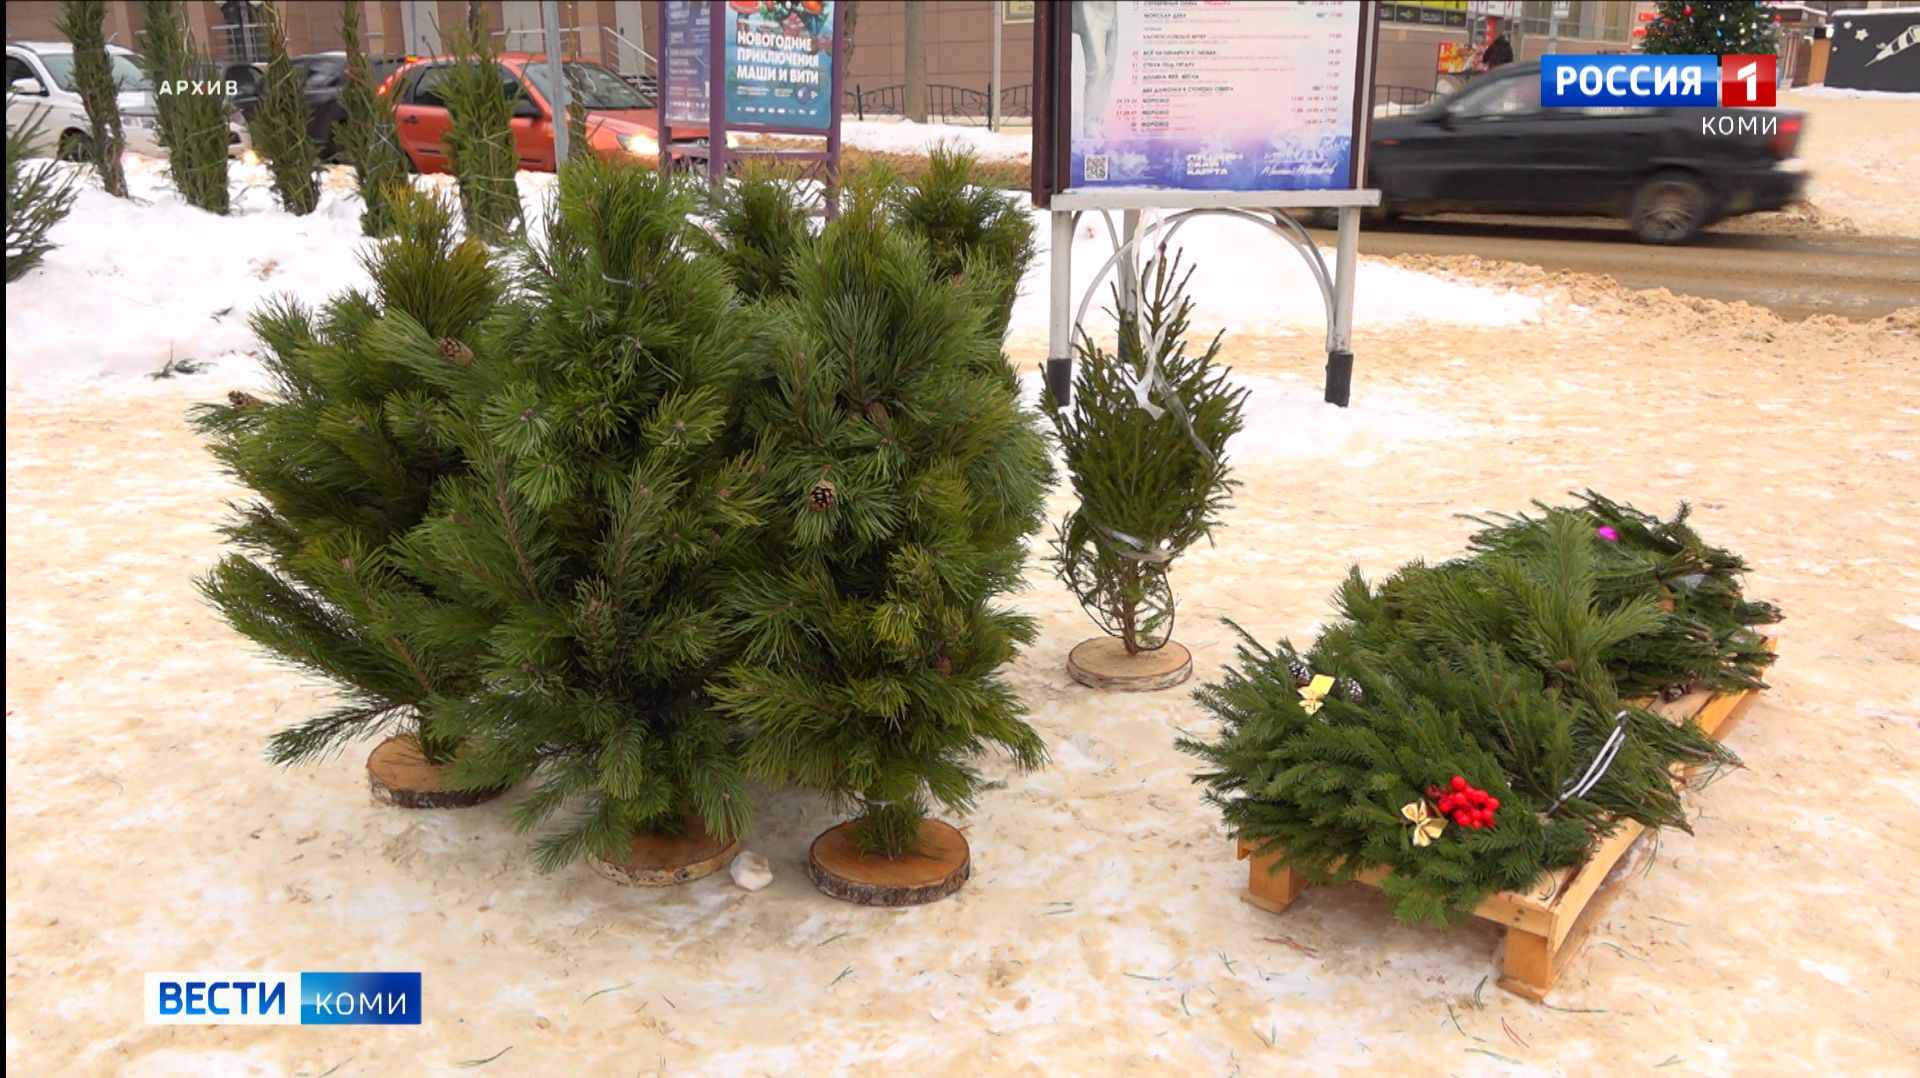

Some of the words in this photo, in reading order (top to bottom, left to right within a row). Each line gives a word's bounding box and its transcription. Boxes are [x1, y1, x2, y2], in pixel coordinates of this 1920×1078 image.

[737, 30, 812, 51] НОВОГОДНИЕ
[737, 47, 819, 67] ПРИКЛЮЧЕНИЯ
[737, 65, 776, 81] МАШИ
[779, 69, 787, 82] И
[790, 69, 819, 84] ВИТИ
